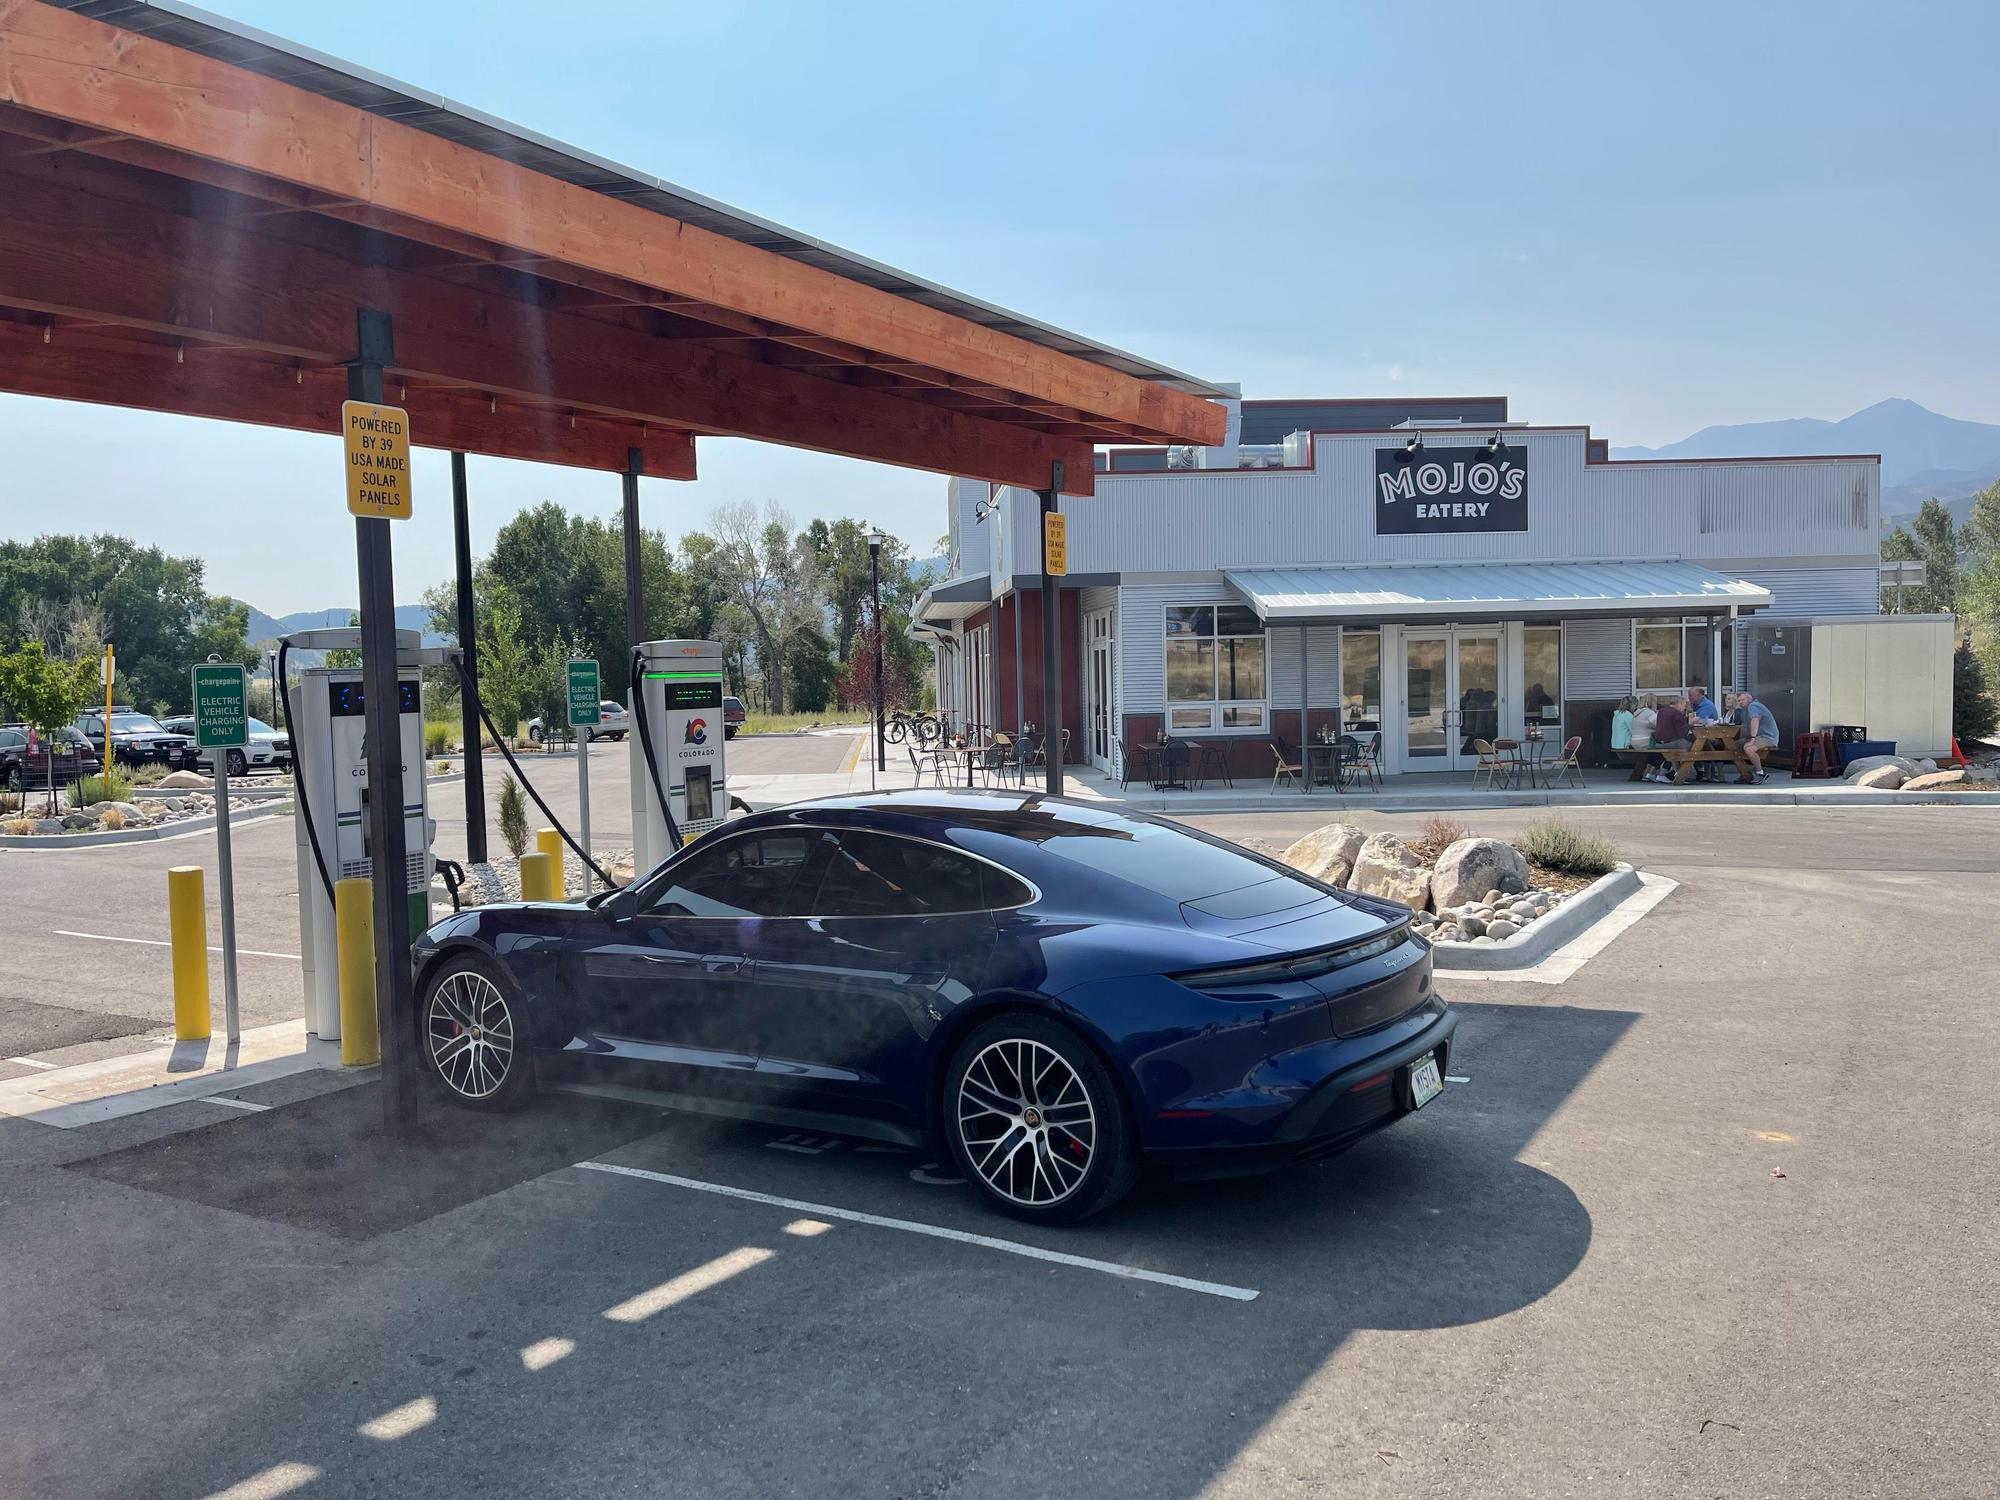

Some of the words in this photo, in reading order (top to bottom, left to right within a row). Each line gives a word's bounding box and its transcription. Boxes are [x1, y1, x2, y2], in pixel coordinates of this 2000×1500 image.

[351, 416, 401, 435] POWERED
[362, 435, 376, 449] BY
[380, 438, 393, 451] 39
[351, 452, 372, 467] USA
[376, 455, 405, 471] MADE
[362, 471, 396, 487] SOLAR
[1378, 461, 1525, 504] MOJO'S
[359, 489, 401, 506] PANELS
[1416, 502, 1489, 518] EATERY
[571, 685, 596, 693] ELECTRIC
[201, 696, 240, 706] ELECTRIC
[573, 693, 595, 701] VEHICLE
[571, 701, 598, 709] CHARGING
[203, 706, 239, 716] VEHICLE
[577, 709, 591, 717] ONLY
[200, 716, 244, 726] CHARGING
[211, 727, 234, 736] ONLY
[678, 749, 715, 758] COLORADO
